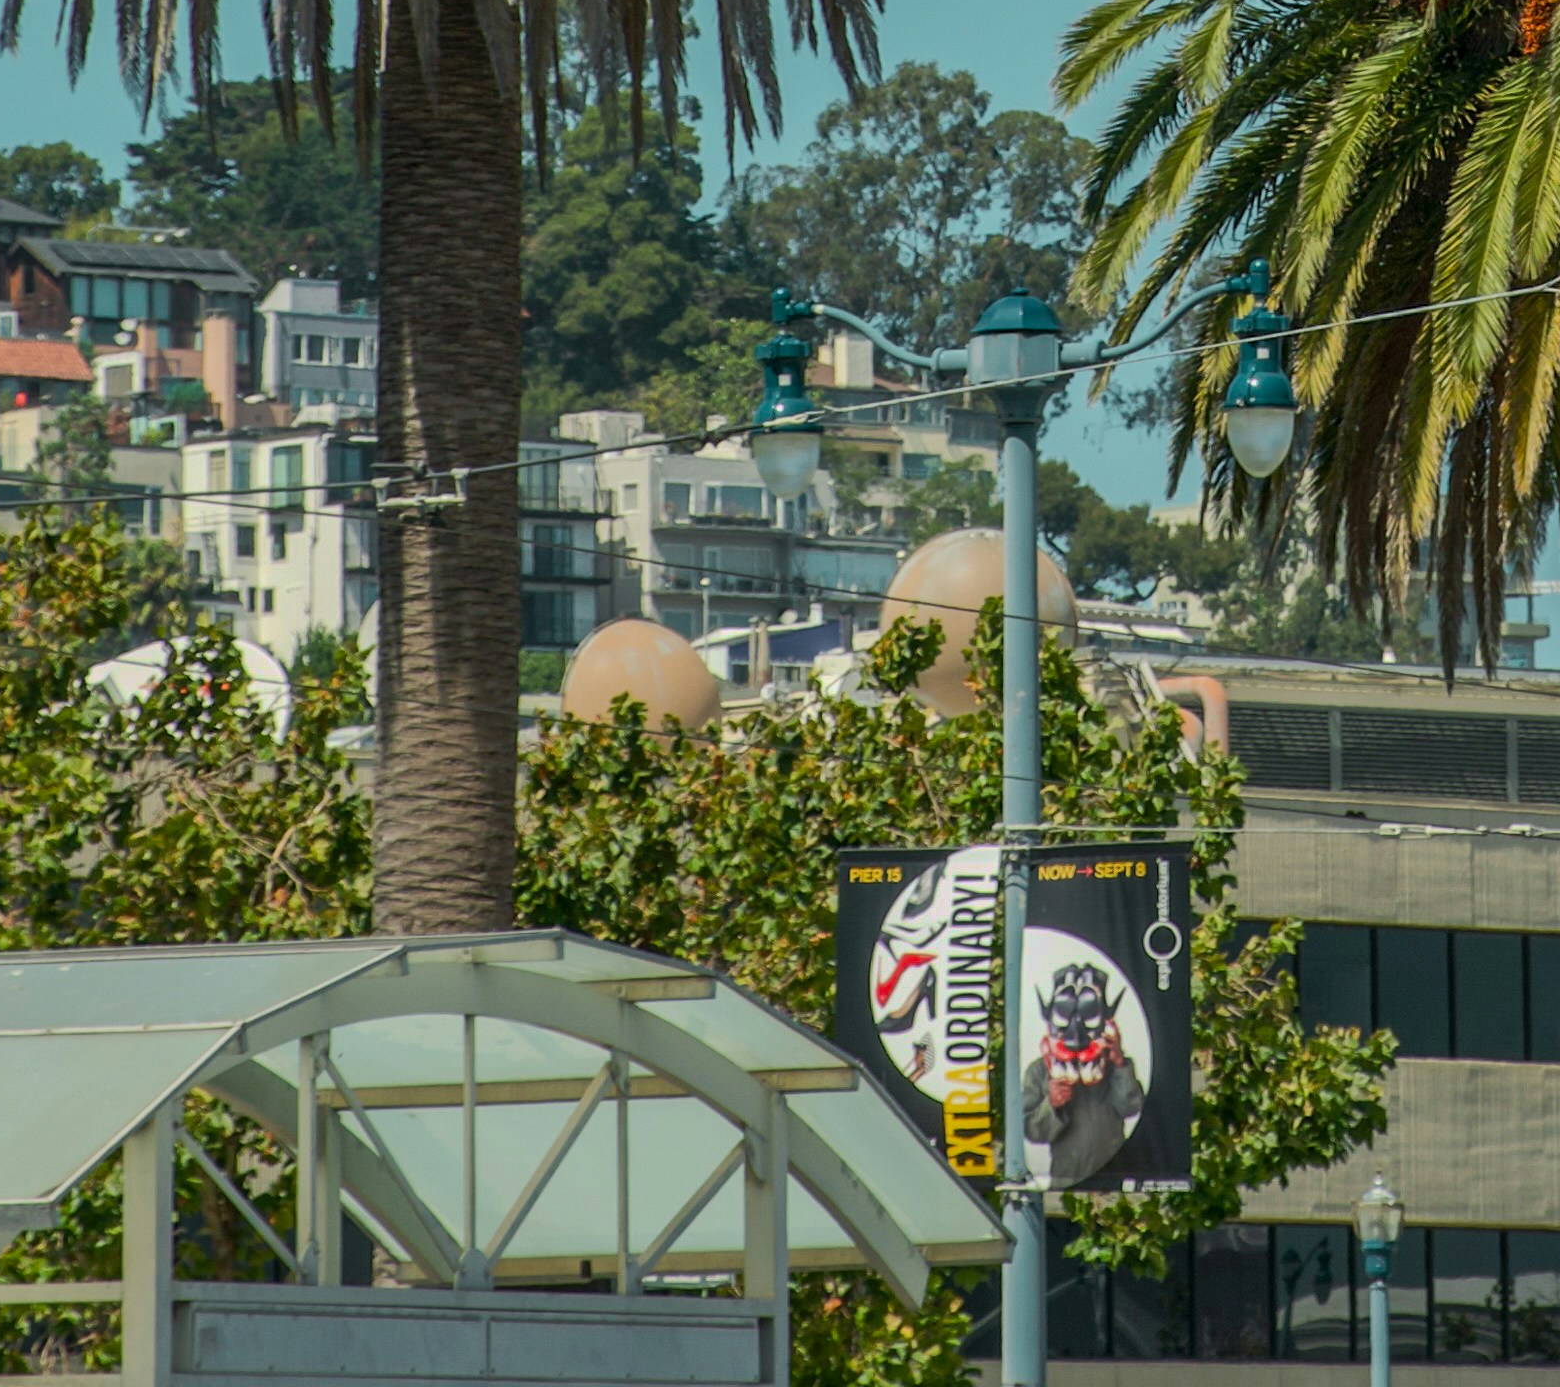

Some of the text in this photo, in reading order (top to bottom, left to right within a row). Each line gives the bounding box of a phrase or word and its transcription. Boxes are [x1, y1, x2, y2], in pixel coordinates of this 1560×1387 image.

[849, 865, 903, 883] PIER 15
[1038, 861, 1147, 881] NOW SEPT 8
